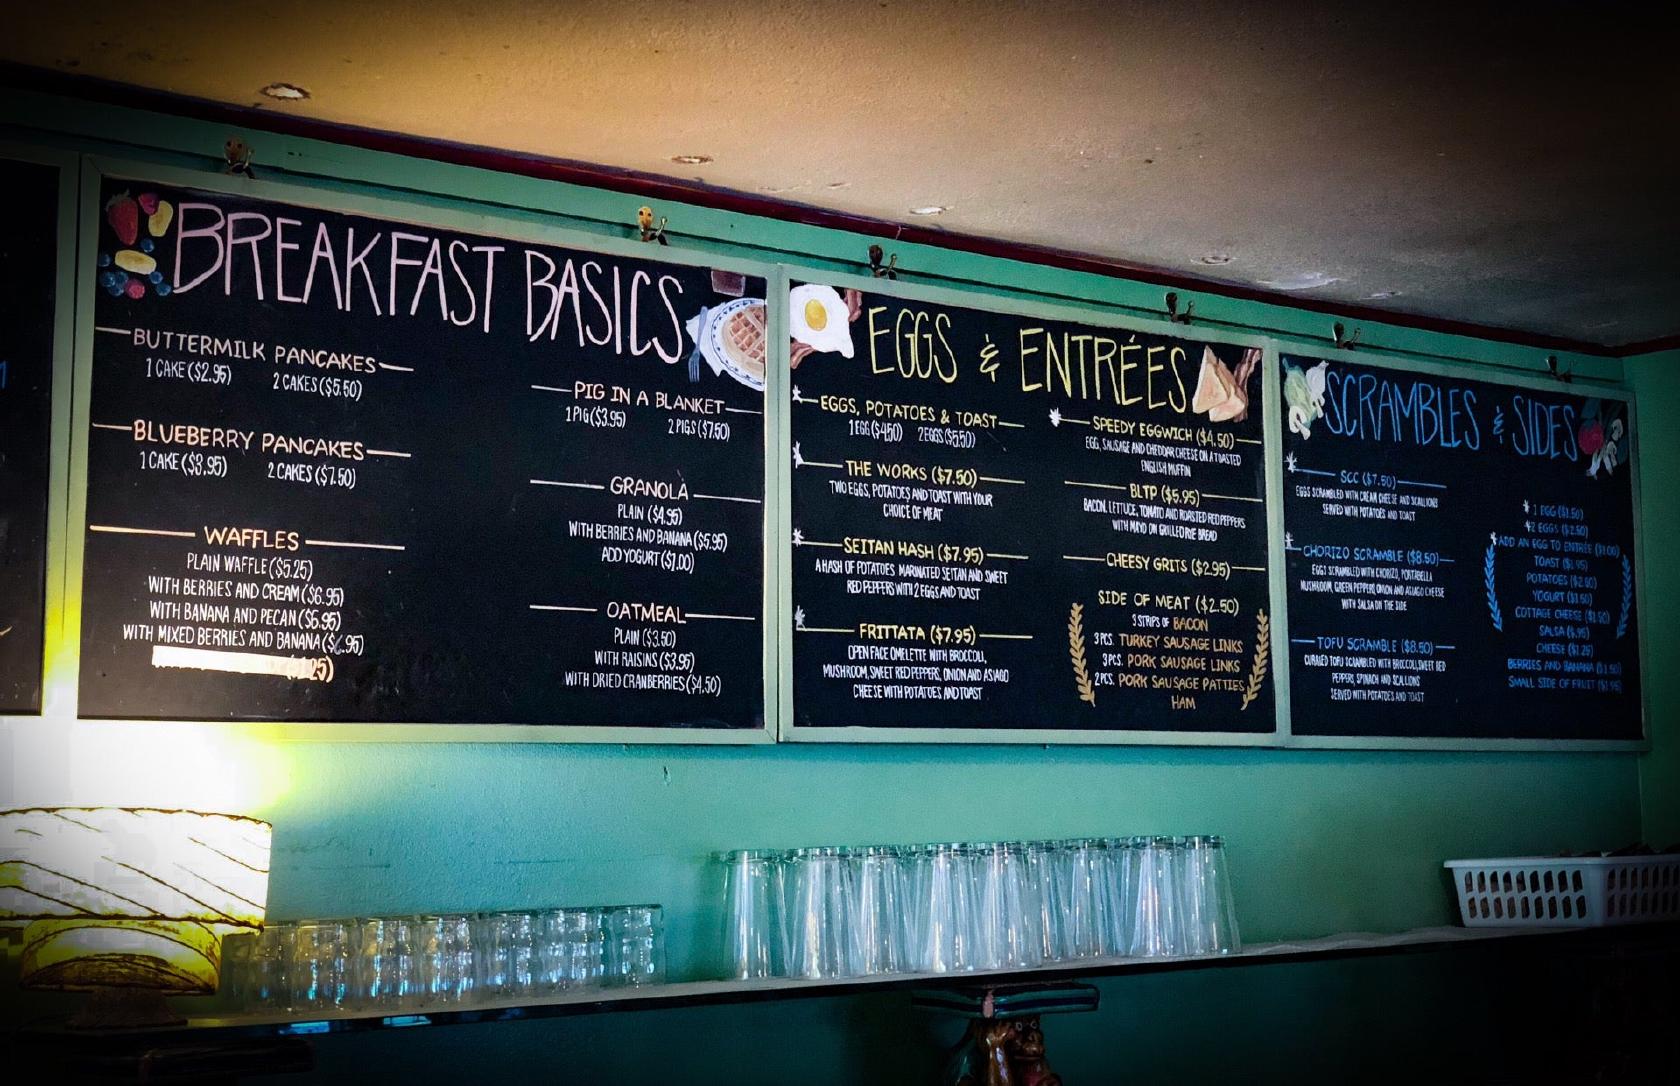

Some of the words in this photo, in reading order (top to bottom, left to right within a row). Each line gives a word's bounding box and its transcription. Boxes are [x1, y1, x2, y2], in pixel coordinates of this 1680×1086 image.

[173, 202, 505, 333] BREAKFAST
[524, 249, 684, 364] BASICS
[133, 328, 266, 361] BUTTERMILK
[274, 345, 376, 373] PANCAKES
[869, 306, 958, 383] EGGS
[980, 334, 999, 382] &
[1020, 328, 1186, 414] ENTRÉES
[146, 358, 152, 378] 1
[155, 358, 187, 378] CAKE
[187, 361, 232, 386] ($2.95)
[272, 371, 280, 390] 2
[282, 374, 318, 393] CAKES
[319, 376, 363, 402] ($5.50)
[574, 380, 605, 400] PIG
[610, 386, 631, 405] IN
[636, 390, 649, 406] A
[656, 391, 726, 415] BLANKET
[566, 406, 571, 422] 1
[573, 406, 588, 424] PIG
[589, 406, 627, 428] ($3.95)
[821, 395, 860, 416] EGGS,
[866, 400, 935, 422] POTATOES
[940, 409, 950, 424] &
[955, 411, 998, 429] TOAST
[1325, 371, 1480, 450] SCRAMBLES
[1493, 405, 1504, 444] &
[1512, 395, 1578, 462] SIDES
[133, 419, 254, 450] BLUEBERRY
[262, 433, 365, 461] PANCAKES
[668, 418, 674, 434] 2
[676, 418, 697, 436] PIGS
[697, 420, 731, 442] ($7.50)
[848, 419, 854, 435] 1
[855, 420, 870, 436] EGG
[918, 427, 925, 441] 2
[925, 428, 944, 444] EGGS
[1092, 415, 1136, 435] SPEEDY
[1139, 423, 1193, 441] EGGWICH
[1196, 426, 1235, 450] ($4.50)
[140, 451, 146, 470] 1
[149, 451, 179, 471] CAKE
[180, 452, 228, 477] ($3.95)
[267, 461, 275, 479] 2
[277, 463, 313, 483] CAKES
[314, 464, 356, 489] ($7.50)
[845, 460, 872, 477] THE
[877, 462, 928, 482] WORKS
[931, 465, 978, 489] ($7.50)
[1340, 470, 1359, 484] SCC
[610, 475, 689, 500] GRANOLA
[829, 480, 847, 494] TWO
[848, 482, 871, 498] EGGS,
[872, 483, 910, 501] POTATOES
[912, 489, 928, 501] AND
[929, 489, 951, 504] TOAST
[953, 490, 972, 505] WITH
[973, 493, 993, 507] YOUR
[1130, 483, 1157, 500] BLTP
[1161, 484, 1200, 508] ($5.95)
[617, 504, 644, 521] PLAIN
[647, 506, 683, 526] ($4.95)
[883, 503, 911, 519] CHOICE
[912, 507, 922, 520] OF
[923, 506, 943, 522] MEAT
[204, 525, 299, 551] WAFFLES
[569, 521, 594, 539] WITH
[596, 524, 634, 541] BERRIES
[636, 527, 655, 543] AND
[657, 528, 692, 546] BANANA
[693, 531, 728, 552] ($5.95)
[601, 547, 622, 562] ADD
[624, 548, 660, 567] YOGURT
[843, 537, 894, 556] SEITAN
[898, 542, 934, 561] HASH
[937, 543, 984, 567] ($7.95)
[1303, 544, 1349, 560] CHORIZO
[1354, 547, 1403, 563] SCRAMBLE
[1407, 550, 1439, 566] ($8.50)
[187, 552, 221, 572] PLAIN
[224, 555, 268, 575] WAFFLE
[269, 557, 313, 581] ($5.25)
[1106, 552, 1149, 571] CHEESY
[1153, 557, 1188, 573] GRITS
[1191, 558, 1231, 581] ($2.95)
[148, 575, 180, 595] WITH
[183, 578, 233, 597] BERRIES
[235, 582, 260, 600] AND
[262, 583, 300, 602] CREAM
[301, 584, 344, 607] ($6.95)
[1098, 590, 1127, 606] SIDE
[1133, 593, 1151, 607] OF
[1155, 595, 1190, 611] MEAT
[1195, 595, 1239, 617] ($2.50)
[150, 600, 181, 620] WITH
[184, 602, 229, 623] BANANA
[233, 607, 257, 624] AND
[260, 608, 297, 627] PECAN
[607, 602, 687, 624] OATMEAL
[1137, 614, 1160, 628] STRIPS
[1161, 616, 1170, 628] OF
[1173, 617, 1208, 632] BACON
[123, 624, 153, 642] WITH
[158, 624, 194, 644] MIXED
[197, 627, 246, 647] BERRIES
[249, 630, 274, 648] AND
[276, 631, 321, 650] BANANA
[615, 627, 640, 645] PLAIN
[643, 628, 676, 649] ($3.50)
[860, 623, 926, 641] FRITTATA
[930, 624, 976, 646] ($7.95)
[1094, 632, 1100, 645] 3
[1119, 633, 1160, 649] TURKEY
[1163, 636, 1210, 651] SAUSAGE
[1213, 638, 1243, 654] LINKS
[1317, 636, 1344, 650] TOFU
[1347, 638, 1397, 653] SCRAMBLE
[595, 650, 619, 667] WITH
[622, 651, 657, 668] RAISINS
[659, 652, 695, 673] ($3.95)
[1102, 652, 1107, 667] 3
[1108, 653, 1123, 667] PCS.
[1127, 653, 1157, 669] PORK
[1160, 656, 1206, 671] SAUSAGE
[1210, 659, 1240, 673] LINKS
[565, 671, 589, 688] WITH
[593, 672, 621, 689] DRIED
[623, 673, 685, 692] CRANBERRIES
[686, 674, 721, 697] ($4.50)
[1094, 672, 1100, 686] 2
[1100, 672, 1115, 686] PCS.
[1118, 673, 1148, 688] PORK
[1151, 675, 1199, 691] SAUSAGE
[1202, 677, 1245, 692] PATTIES
[1171, 695, 1196, 710] HAM
